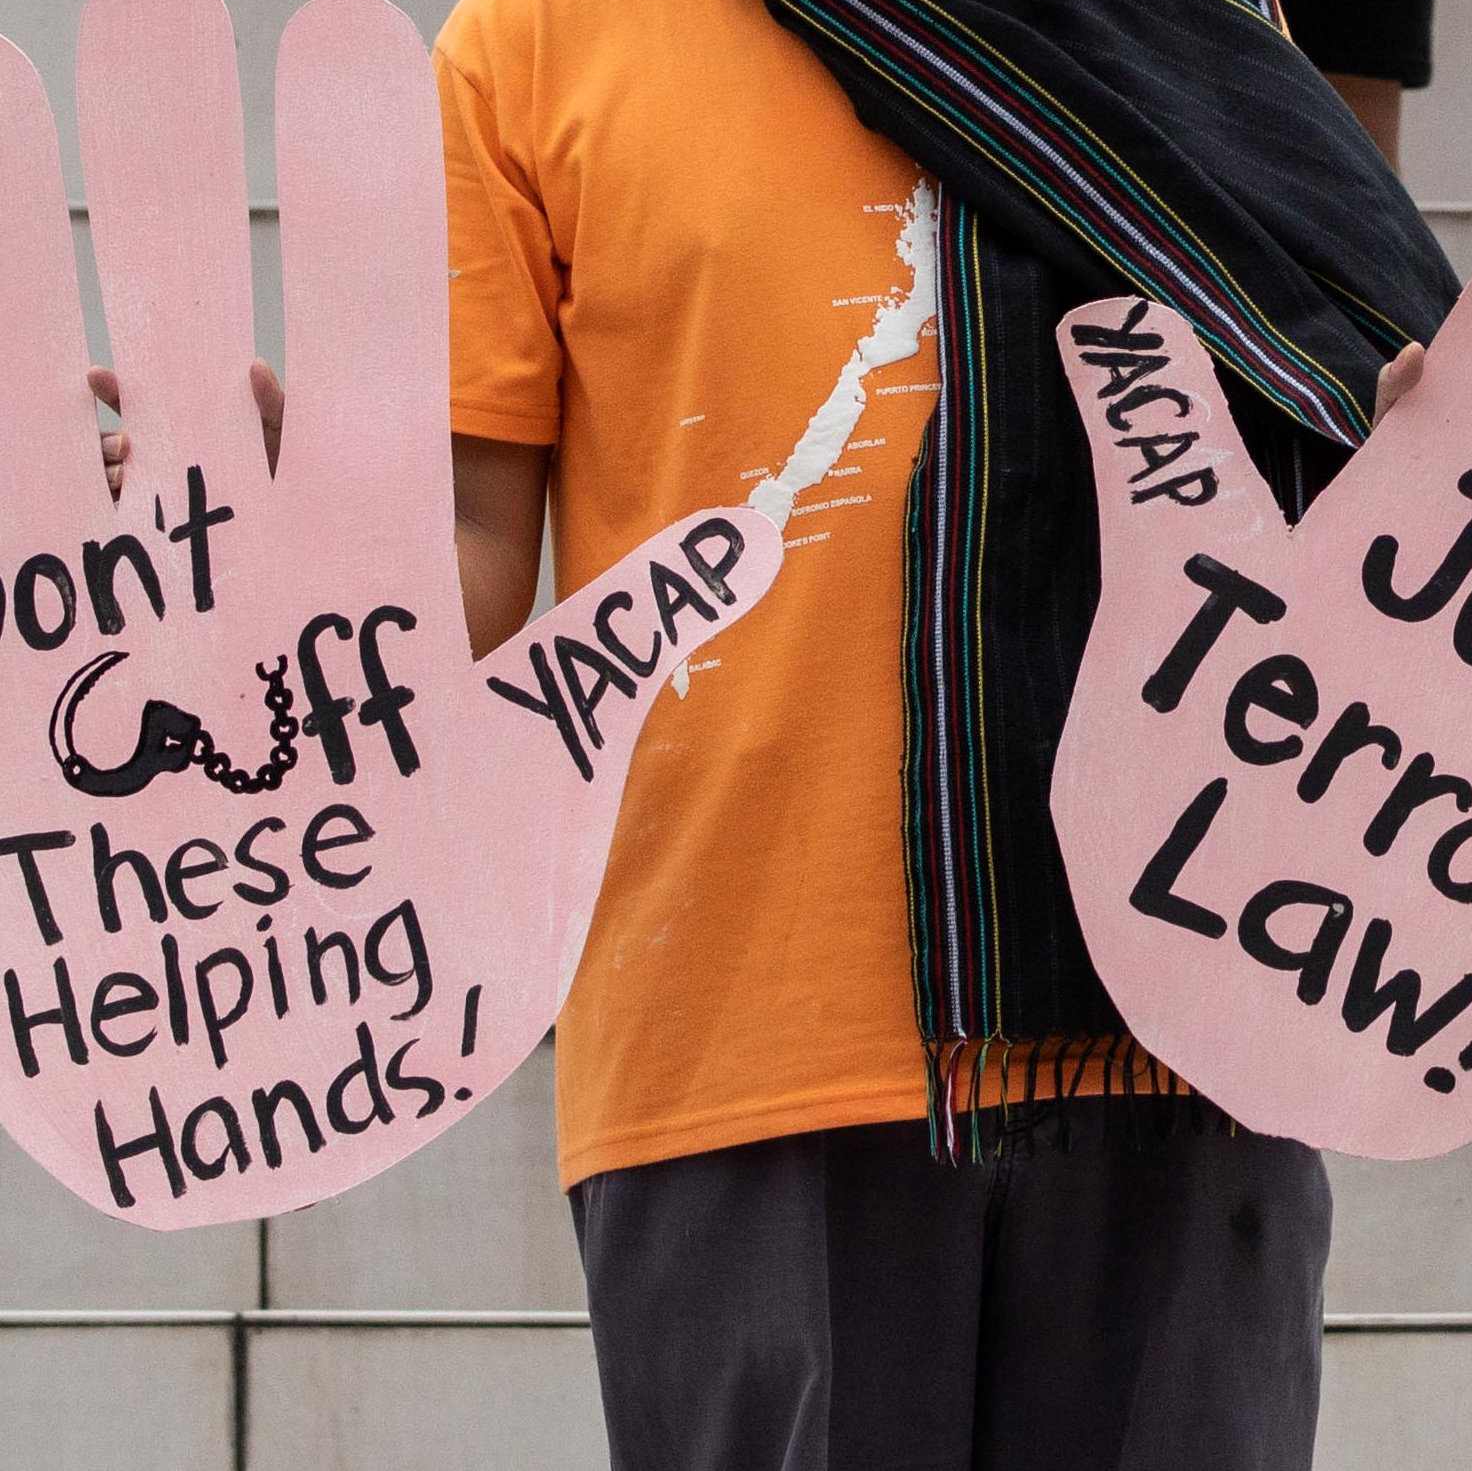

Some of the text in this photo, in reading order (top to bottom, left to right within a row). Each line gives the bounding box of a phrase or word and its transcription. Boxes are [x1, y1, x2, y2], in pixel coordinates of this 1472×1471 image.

[1072, 300, 1219, 508] YACAP
[0, 464, 234, 650] on't
[487, 517, 745, 782] YACAP
[0, 803, 375, 945] These
[3, 899, 431, 1078] Helping
[93, 986, 482, 1208] Hands!
